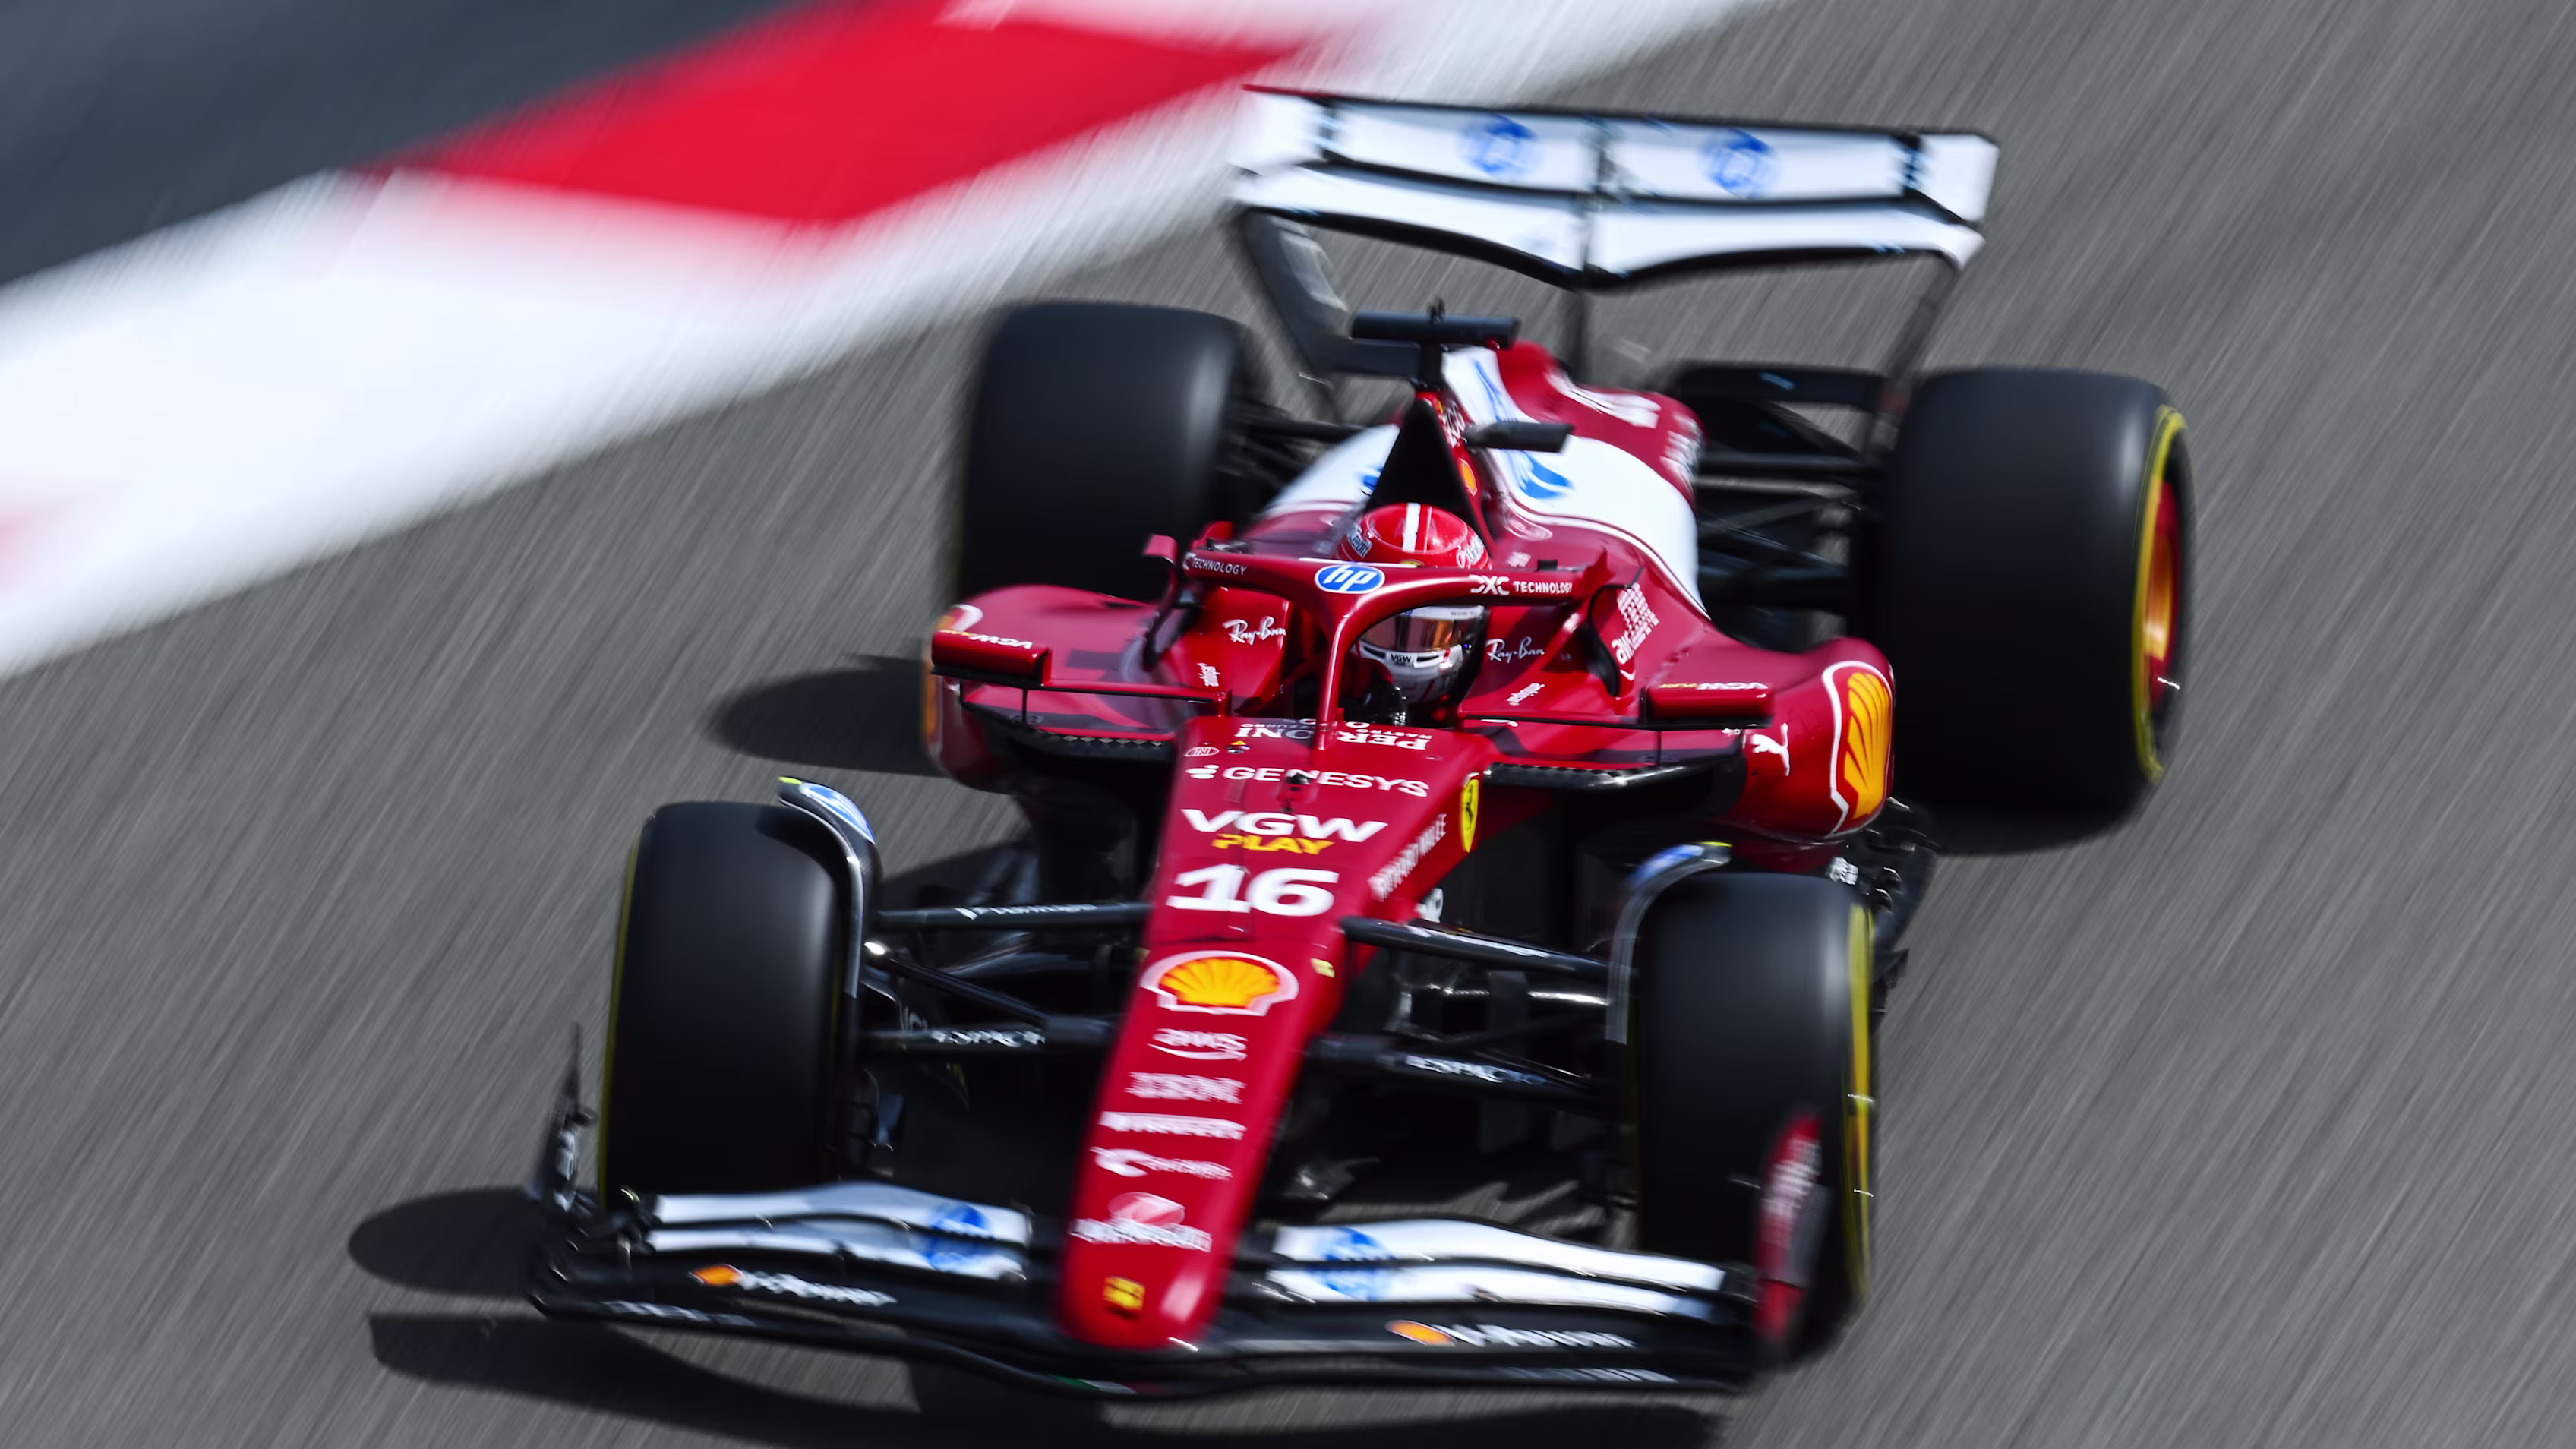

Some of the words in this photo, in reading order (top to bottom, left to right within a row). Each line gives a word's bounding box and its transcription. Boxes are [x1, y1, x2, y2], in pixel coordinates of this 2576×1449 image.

[1192, 557, 1247, 576] TECHNOLOGY
[1322, 565, 1378, 591] hp
[1469, 574, 1510, 596] DXC
[1513, 581, 1573, 595] TECHNOLOGY
[1222, 615, 1286, 646] Ray-Ban
[1485, 636, 1545, 664] Ray-Ban
[1223, 766, 1430, 798] GENESYS
[1181, 809, 1388, 843] VGW
[1211, 834, 1336, 855] PLAY
[1166, 863, 1340, 917] 16
